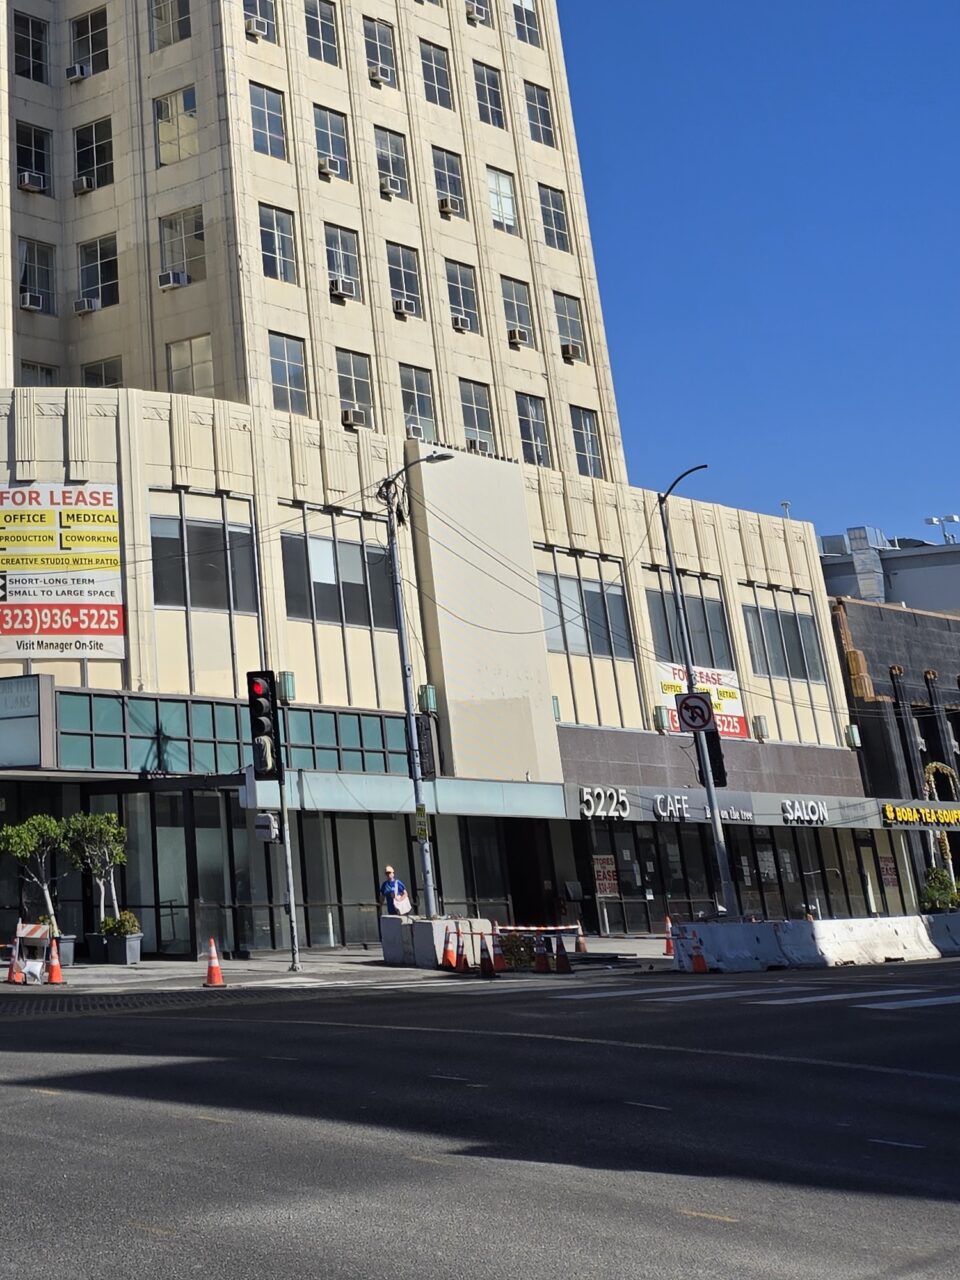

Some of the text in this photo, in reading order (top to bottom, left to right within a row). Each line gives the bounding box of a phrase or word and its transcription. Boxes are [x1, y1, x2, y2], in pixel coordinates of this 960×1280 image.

[0, 490, 114, 507] FOR LEASE
[3, 513, 47, 524] OFFICE
[66, 513, 119, 524] MEDICAL
[0, 534, 54, 543] PRODUCTION
[64, 534, 118, 543] COWORKING
[0, 557, 119, 566] CREATIVE STUDIO WITH PATIO
[8, 577, 95, 586] SHORT-LONG TERM
[8, 589, 116, 598] SMALL TO LARGE SPACE
[16, 640, 104, 653] Visit Manager On-Site
[663, 683, 683, 693] OFFICE
[580, 787, 630, 818] 5225
[654, 794, 691, 818] CAFE
[781, 799, 829, 821] SALON
[895, 807, 919, 822] BOBA
[920, 808, 937, 823] TEA
